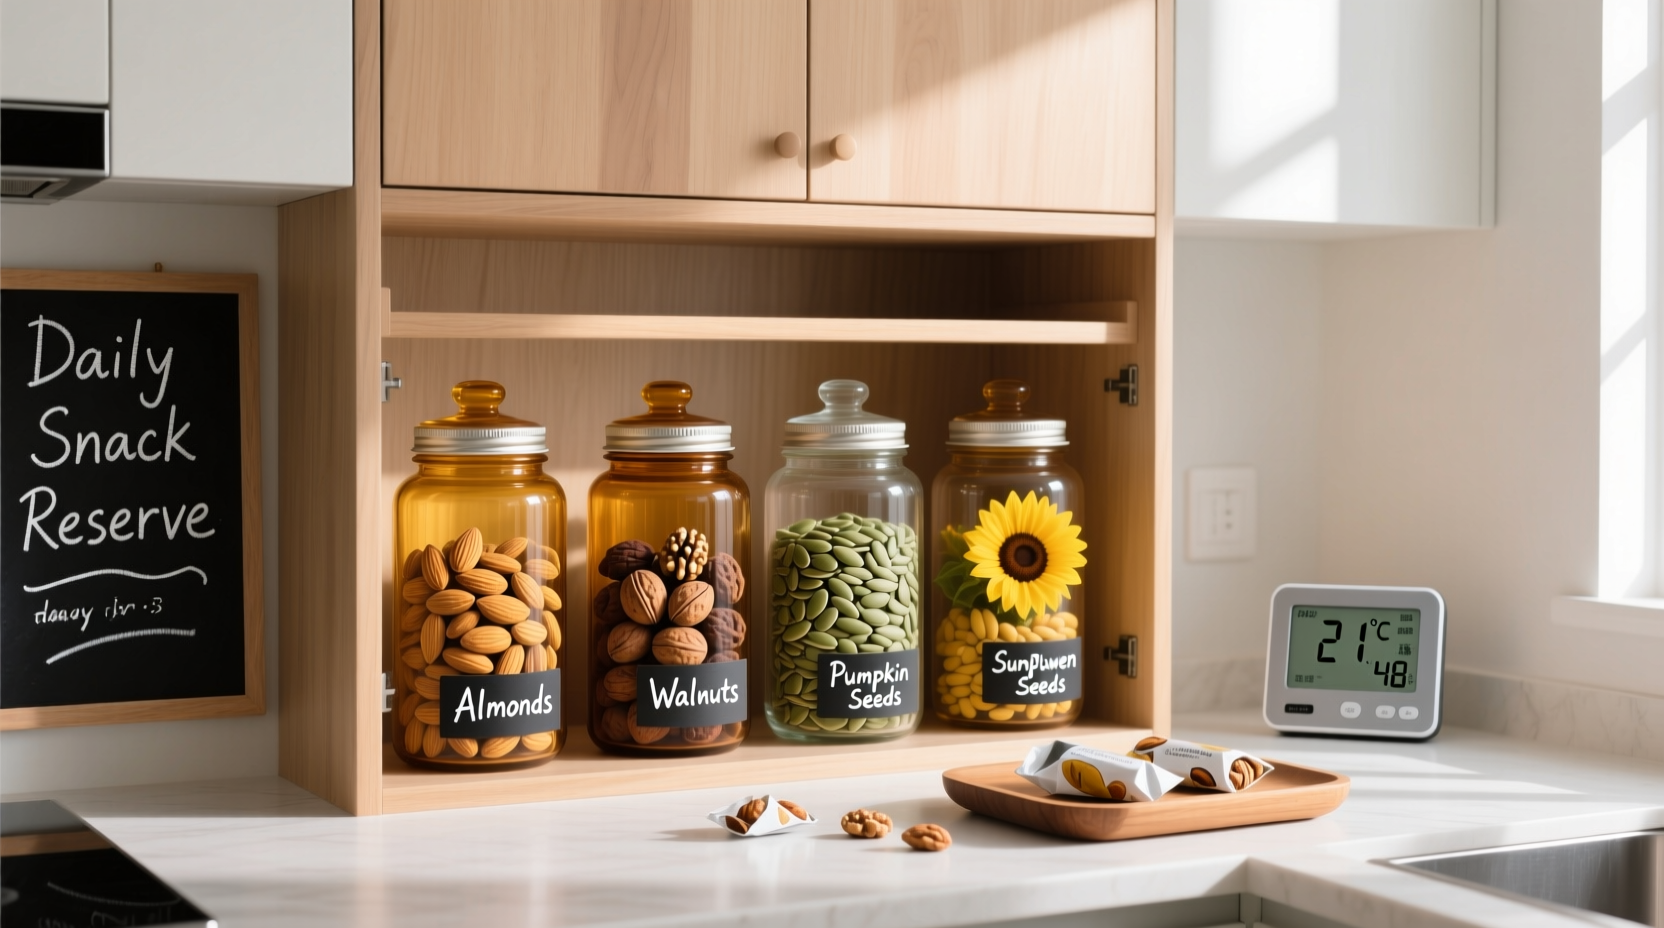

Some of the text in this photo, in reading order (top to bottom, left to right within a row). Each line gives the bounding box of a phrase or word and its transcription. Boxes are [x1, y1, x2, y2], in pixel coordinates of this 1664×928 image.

[28, 314, 176, 408] Daily
[30, 404, 196, 468] Snack
[19, 486, 216, 552] Reserve
[829, 660, 909, 692] Pumpkin
[1015, 673, 1066, 696] Seeds
[1374, 661, 1408, 689] 48
[453, 683, 553, 723] Almonds
[649, 677, 739, 709] Walnuts
[848, 685, 902, 710] Seeds
